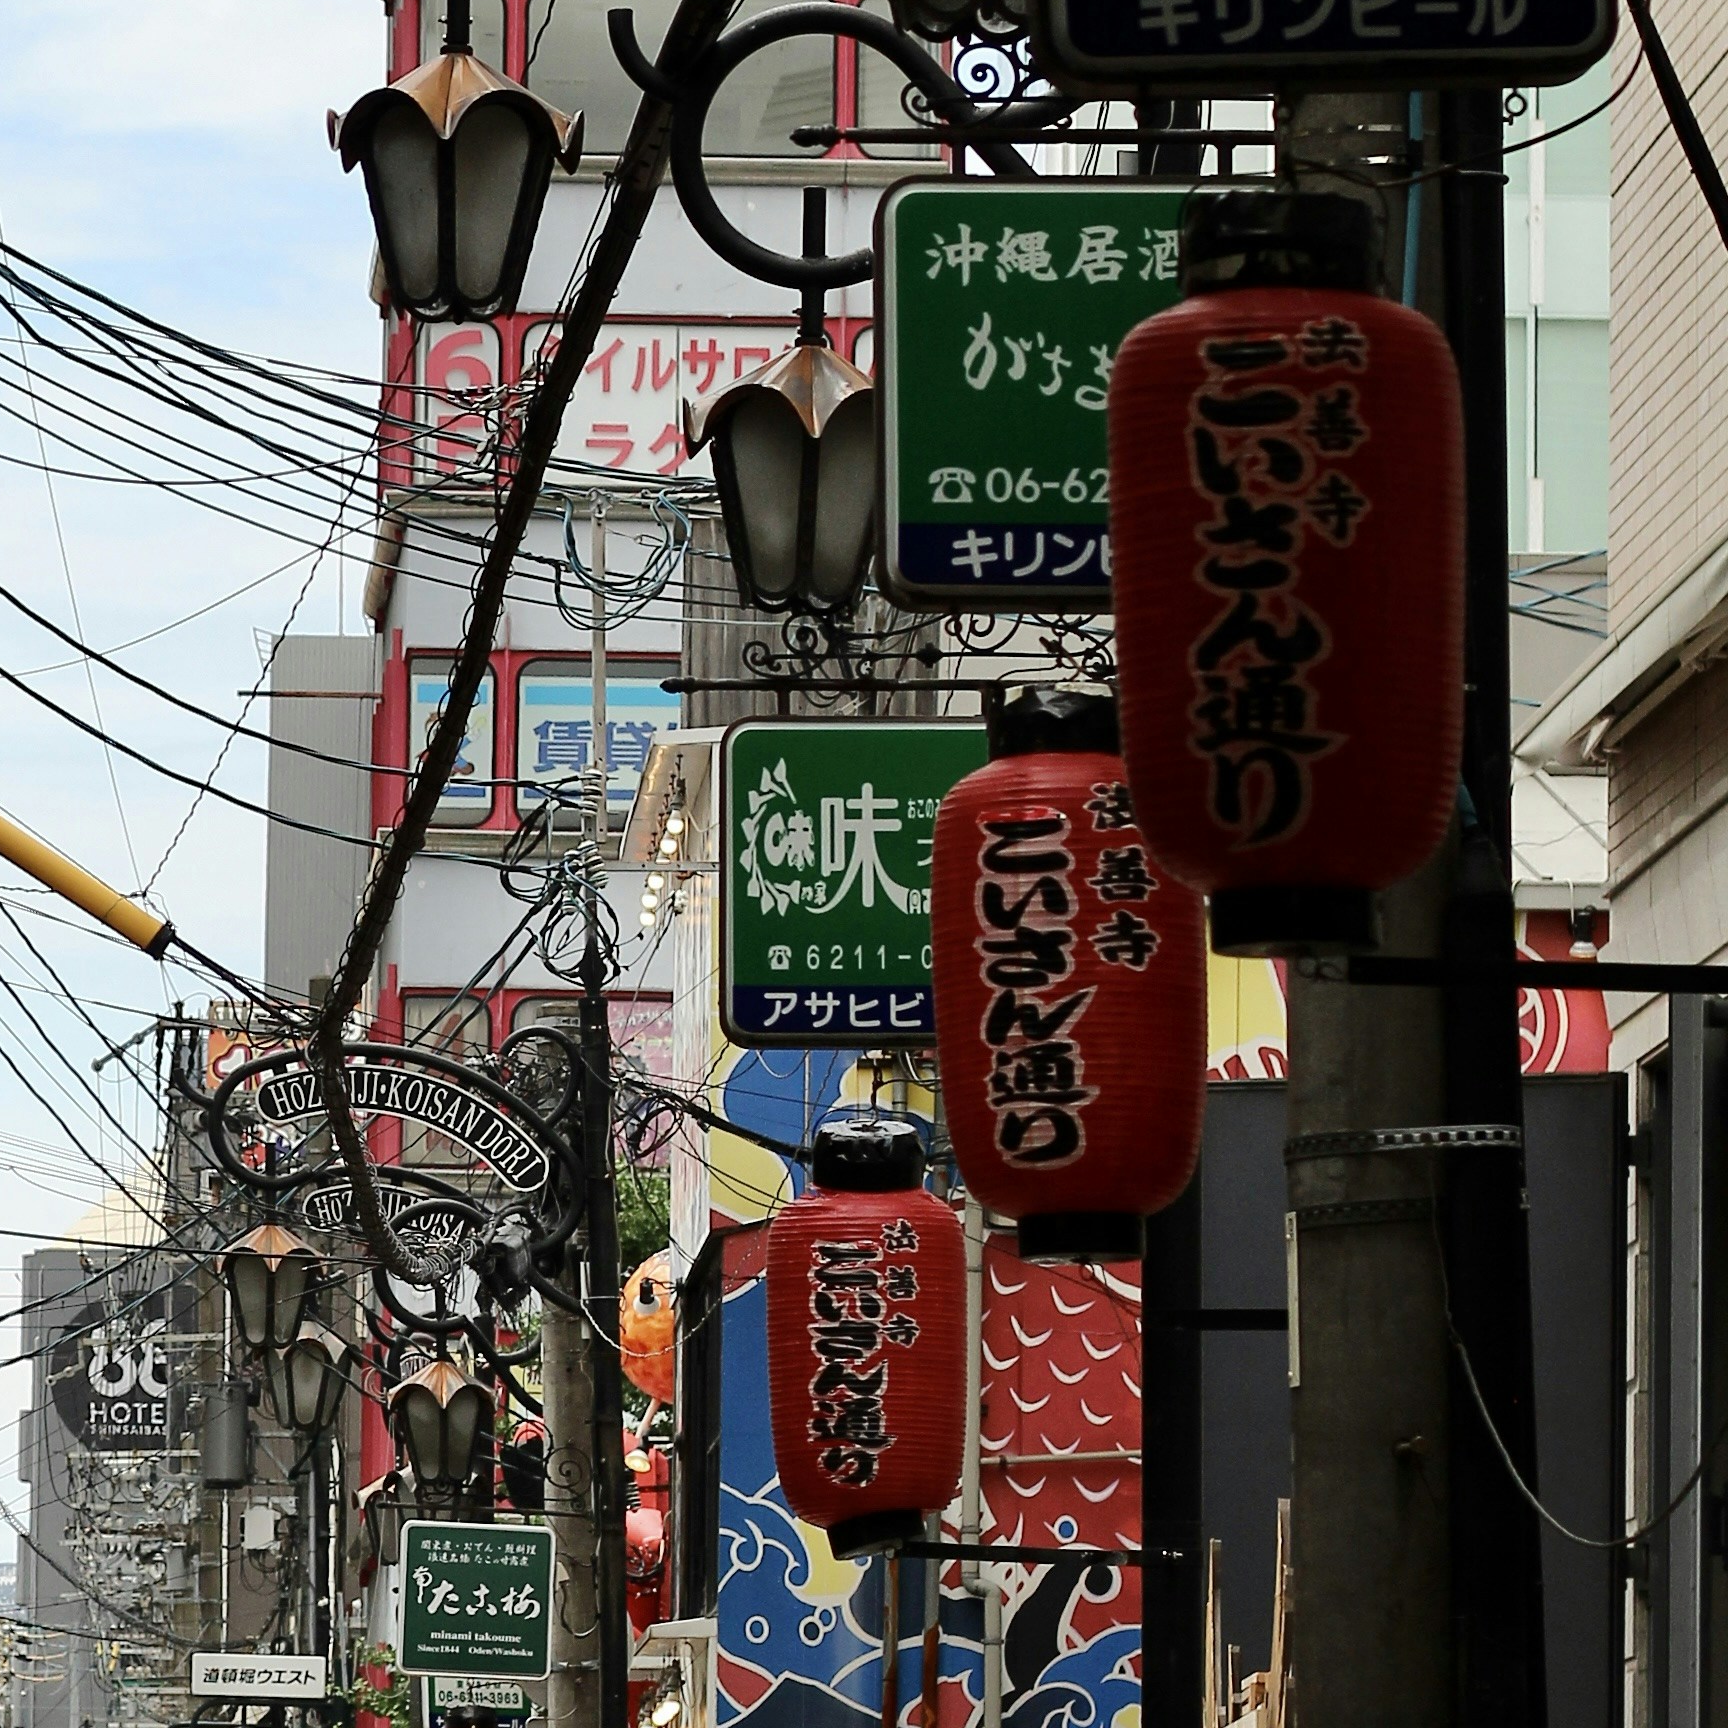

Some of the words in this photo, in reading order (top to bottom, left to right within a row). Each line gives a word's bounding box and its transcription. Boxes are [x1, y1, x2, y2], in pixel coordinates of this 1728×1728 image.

[543, 338, 796, 395] イルサロ
[1299, 318, 1370, 547] 法善寺
[951, 529, 1114, 577] キリン
[1188, 333, 1349, 851] こいさん通り
[534, 721, 678, 771] 賃貸
[1085, 781, 1161, 972] 法善寺
[763, 991, 925, 1028] アサヒビ
[974, 805, 1101, 1169] こいさん通り
[474, 1120, 543, 1184] DŌRI
[879, 1218, 922, 1348] 法善寺
[806, 1240, 899, 1488] こいさん通り
[430, 1630, 472, 1641] minami
[474, 1631, 522, 1643] takoume
[202, 1667, 317, 1685] 道頓堀ウエスト
